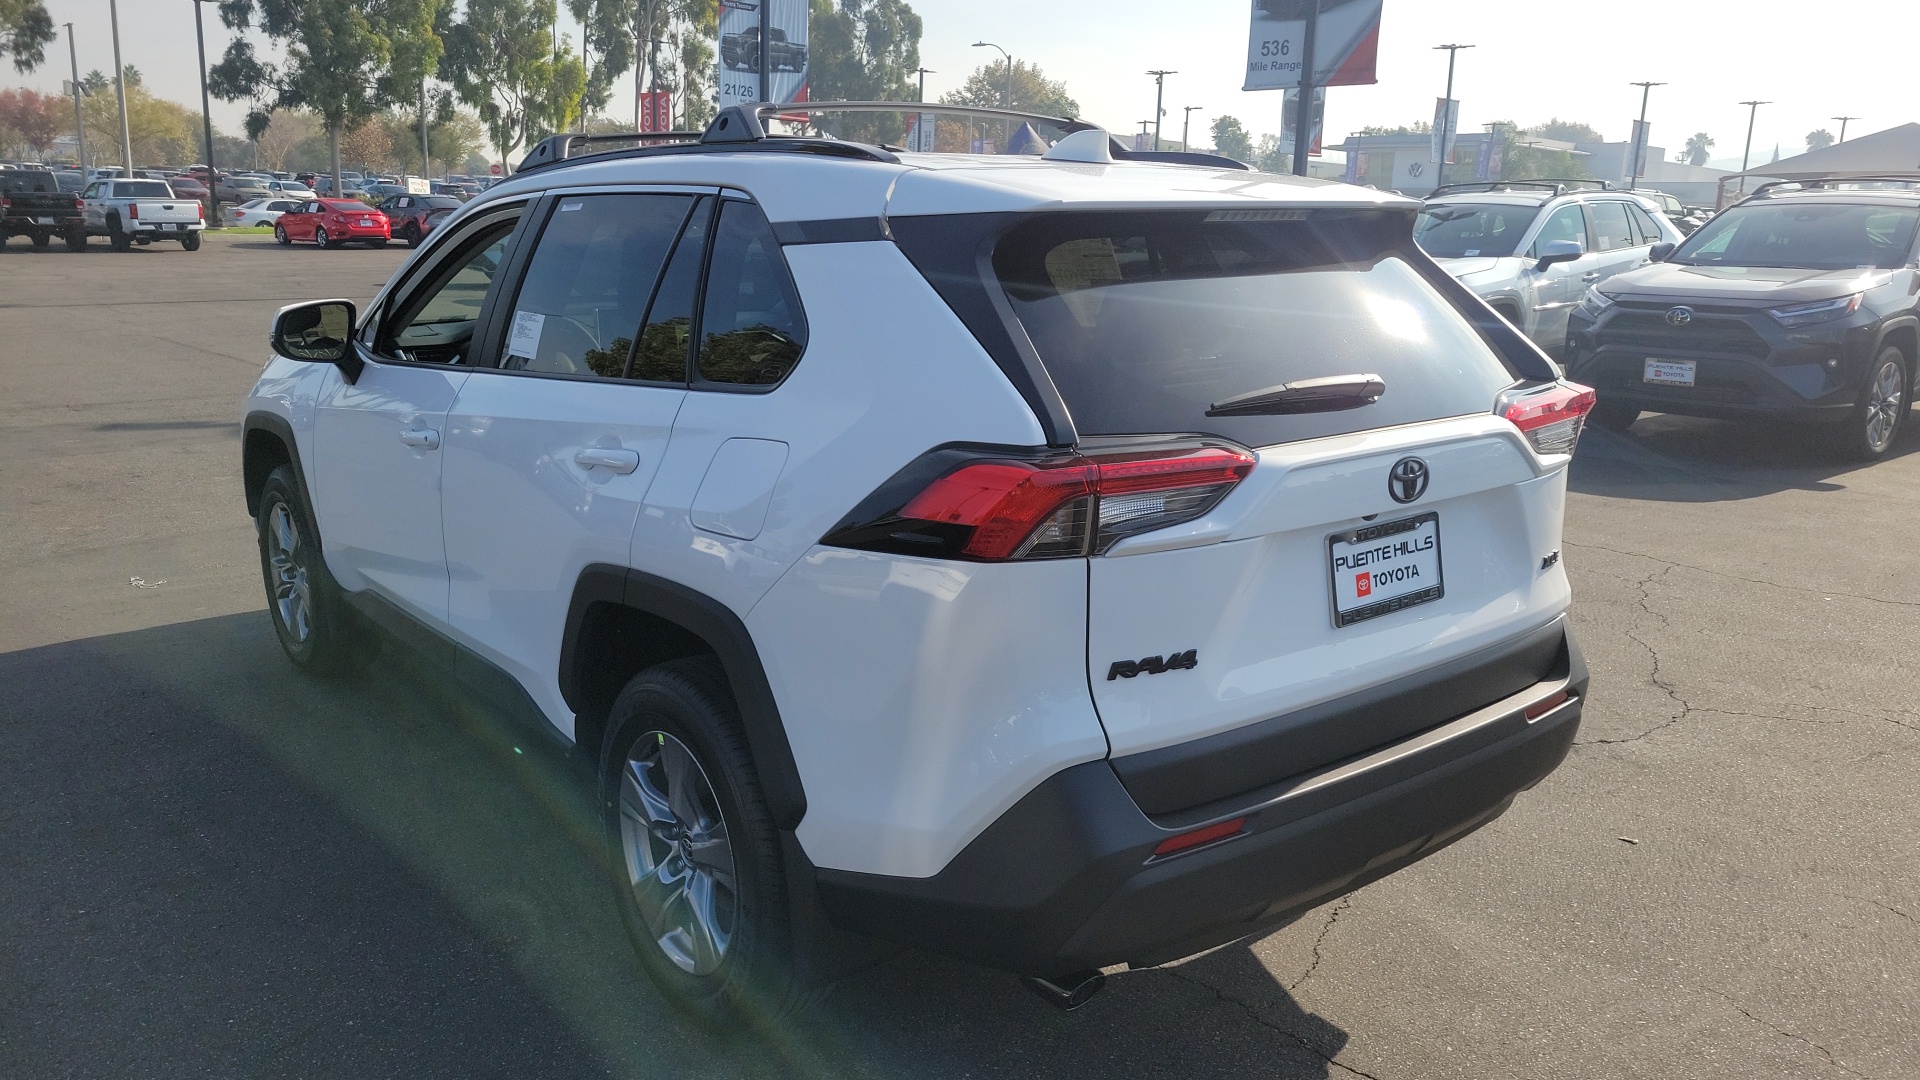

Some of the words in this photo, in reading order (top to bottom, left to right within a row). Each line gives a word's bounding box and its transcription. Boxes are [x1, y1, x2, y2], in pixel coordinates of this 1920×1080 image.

[1261, 39, 1290, 57] 536
[1250, 62, 1268, 72] Mile
[1270, 60, 1302, 72] Range
[724, 83, 753, 98] 21/26
[1357, 518, 1414, 541] TOYOTA
[1335, 545, 1391, 572] PUENTE
[1393, 535, 1434, 557] HILLS
[1372, 564, 1420, 588] TOYOTA
[1400, 587, 1439, 608] HILLS
[1107, 649, 1198, 680] RAV4
